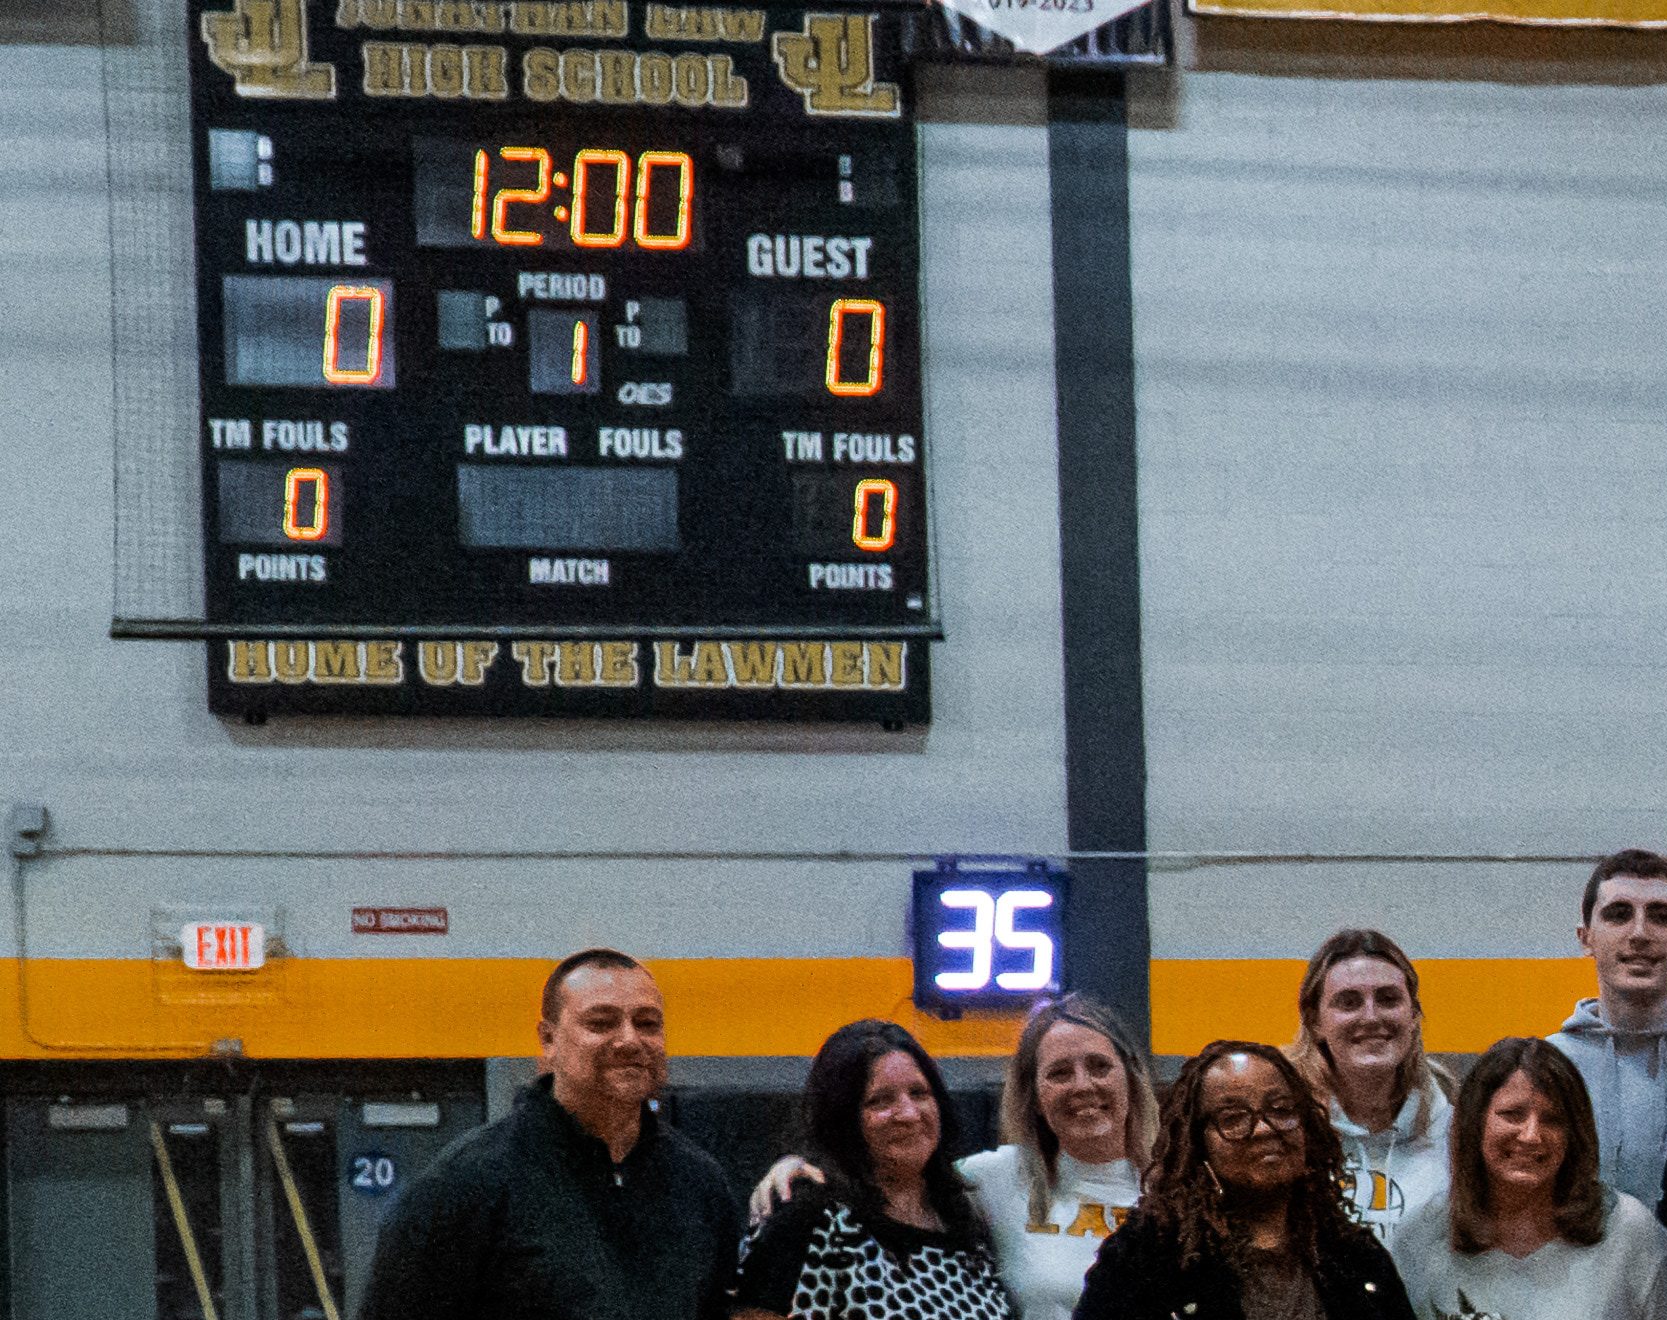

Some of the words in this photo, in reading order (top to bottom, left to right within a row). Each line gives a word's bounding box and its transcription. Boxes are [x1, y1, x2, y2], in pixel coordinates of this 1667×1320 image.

[363, 42, 507, 98] HIGH
[522, 47, 748, 107] SCHOOL
[472, 146, 694, 248] 12:00
[246, 219, 368, 266] HOME
[746, 233, 873, 280] GUEST
[517, 271, 606, 300] PERIOD
[323, 285, 385, 385] 0
[826, 299, 886, 397] 0
[210, 420, 252, 450] TM
[263, 422, 349, 453] FOULS
[464, 425, 568, 457] PLAYER
[599, 428, 684, 460] FOULS
[783, 431, 826, 461] TM
[832, 433, 915, 464] FOULS
[283, 468, 329, 541] 0
[852, 478, 898, 552] 0
[238, 553, 327, 583] POINTS
[529, 557, 609, 586] MATCH
[809, 562, 894, 591] POINTS
[228, 640, 403, 685] HOME
[418, 641, 500, 686] OF
[511, 641, 641, 688] THE
[653, 641, 907, 692] LAWMEN
[196, 925, 252, 968] EXIT
[933, 889, 1055, 991] 35
[354, 1156, 393, 1188] 20
